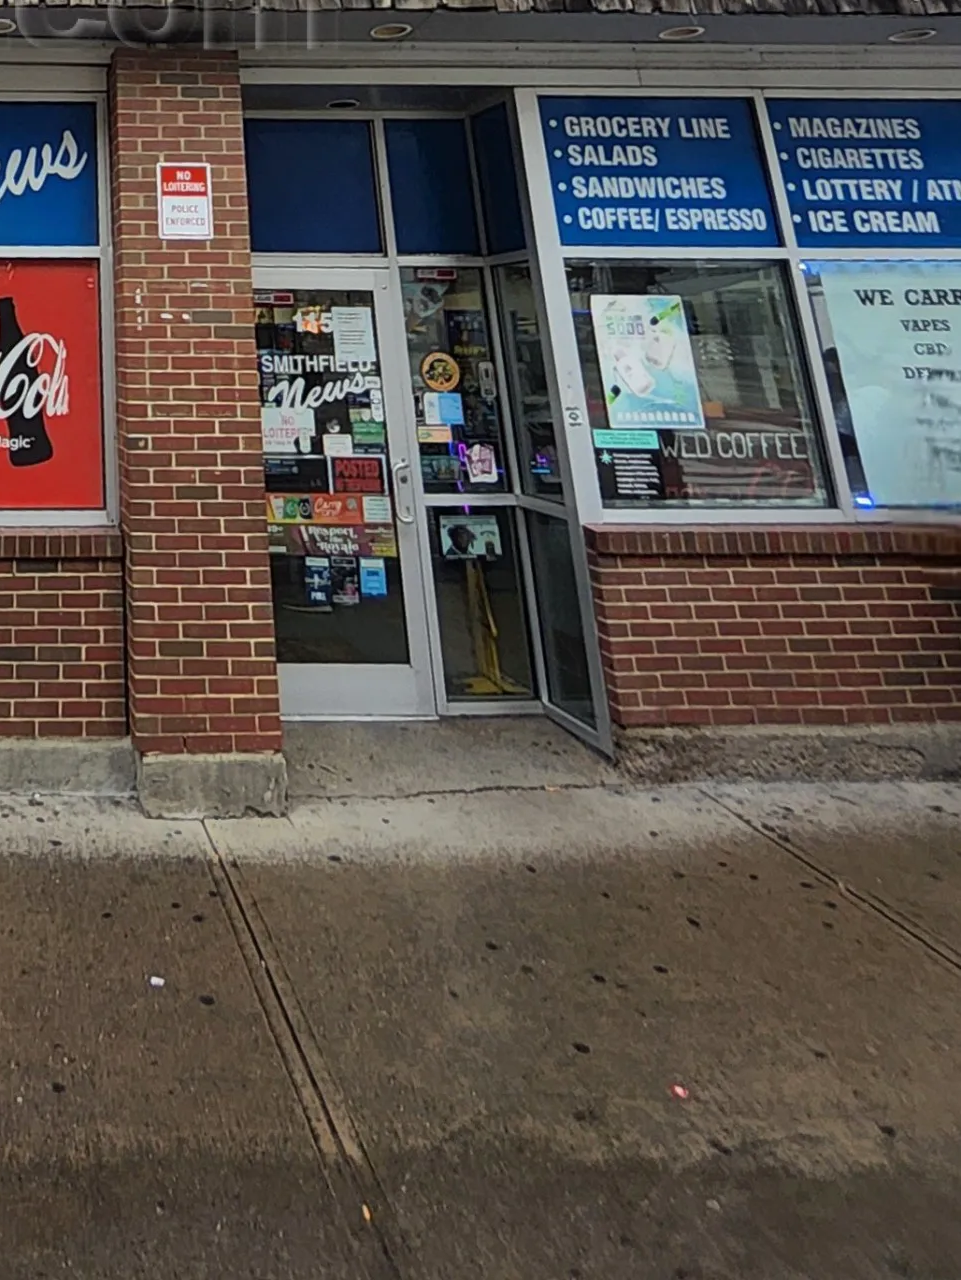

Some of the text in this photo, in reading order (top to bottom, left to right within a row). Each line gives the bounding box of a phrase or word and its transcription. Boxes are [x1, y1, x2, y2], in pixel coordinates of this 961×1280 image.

[564, 116, 731, 139] GROCERY LINE
[789, 117, 921, 139] MAGAZINES
[567, 145, 658, 167] SALADS
[797, 148, 924, 170] CIGARETTES
[175, 170, 192, 181] NO
[162, 182, 206, 193] LOITERING
[572, 176, 726, 199] SANDWICHES
[802, 179, 903, 201] LOTTERY
[171, 205, 199, 214] POLICE
[578, 208, 767, 233] COFFEE/ ESPRESSO
[165, 216, 206, 227] ENFORCED
[809, 210, 941, 233] ICE CREAM
[854, 289, 895, 306] WE
[899, 319, 952, 332] VAPES
[267, 372, 365, 414] News
[718, 432, 808, 459] COFFEE
